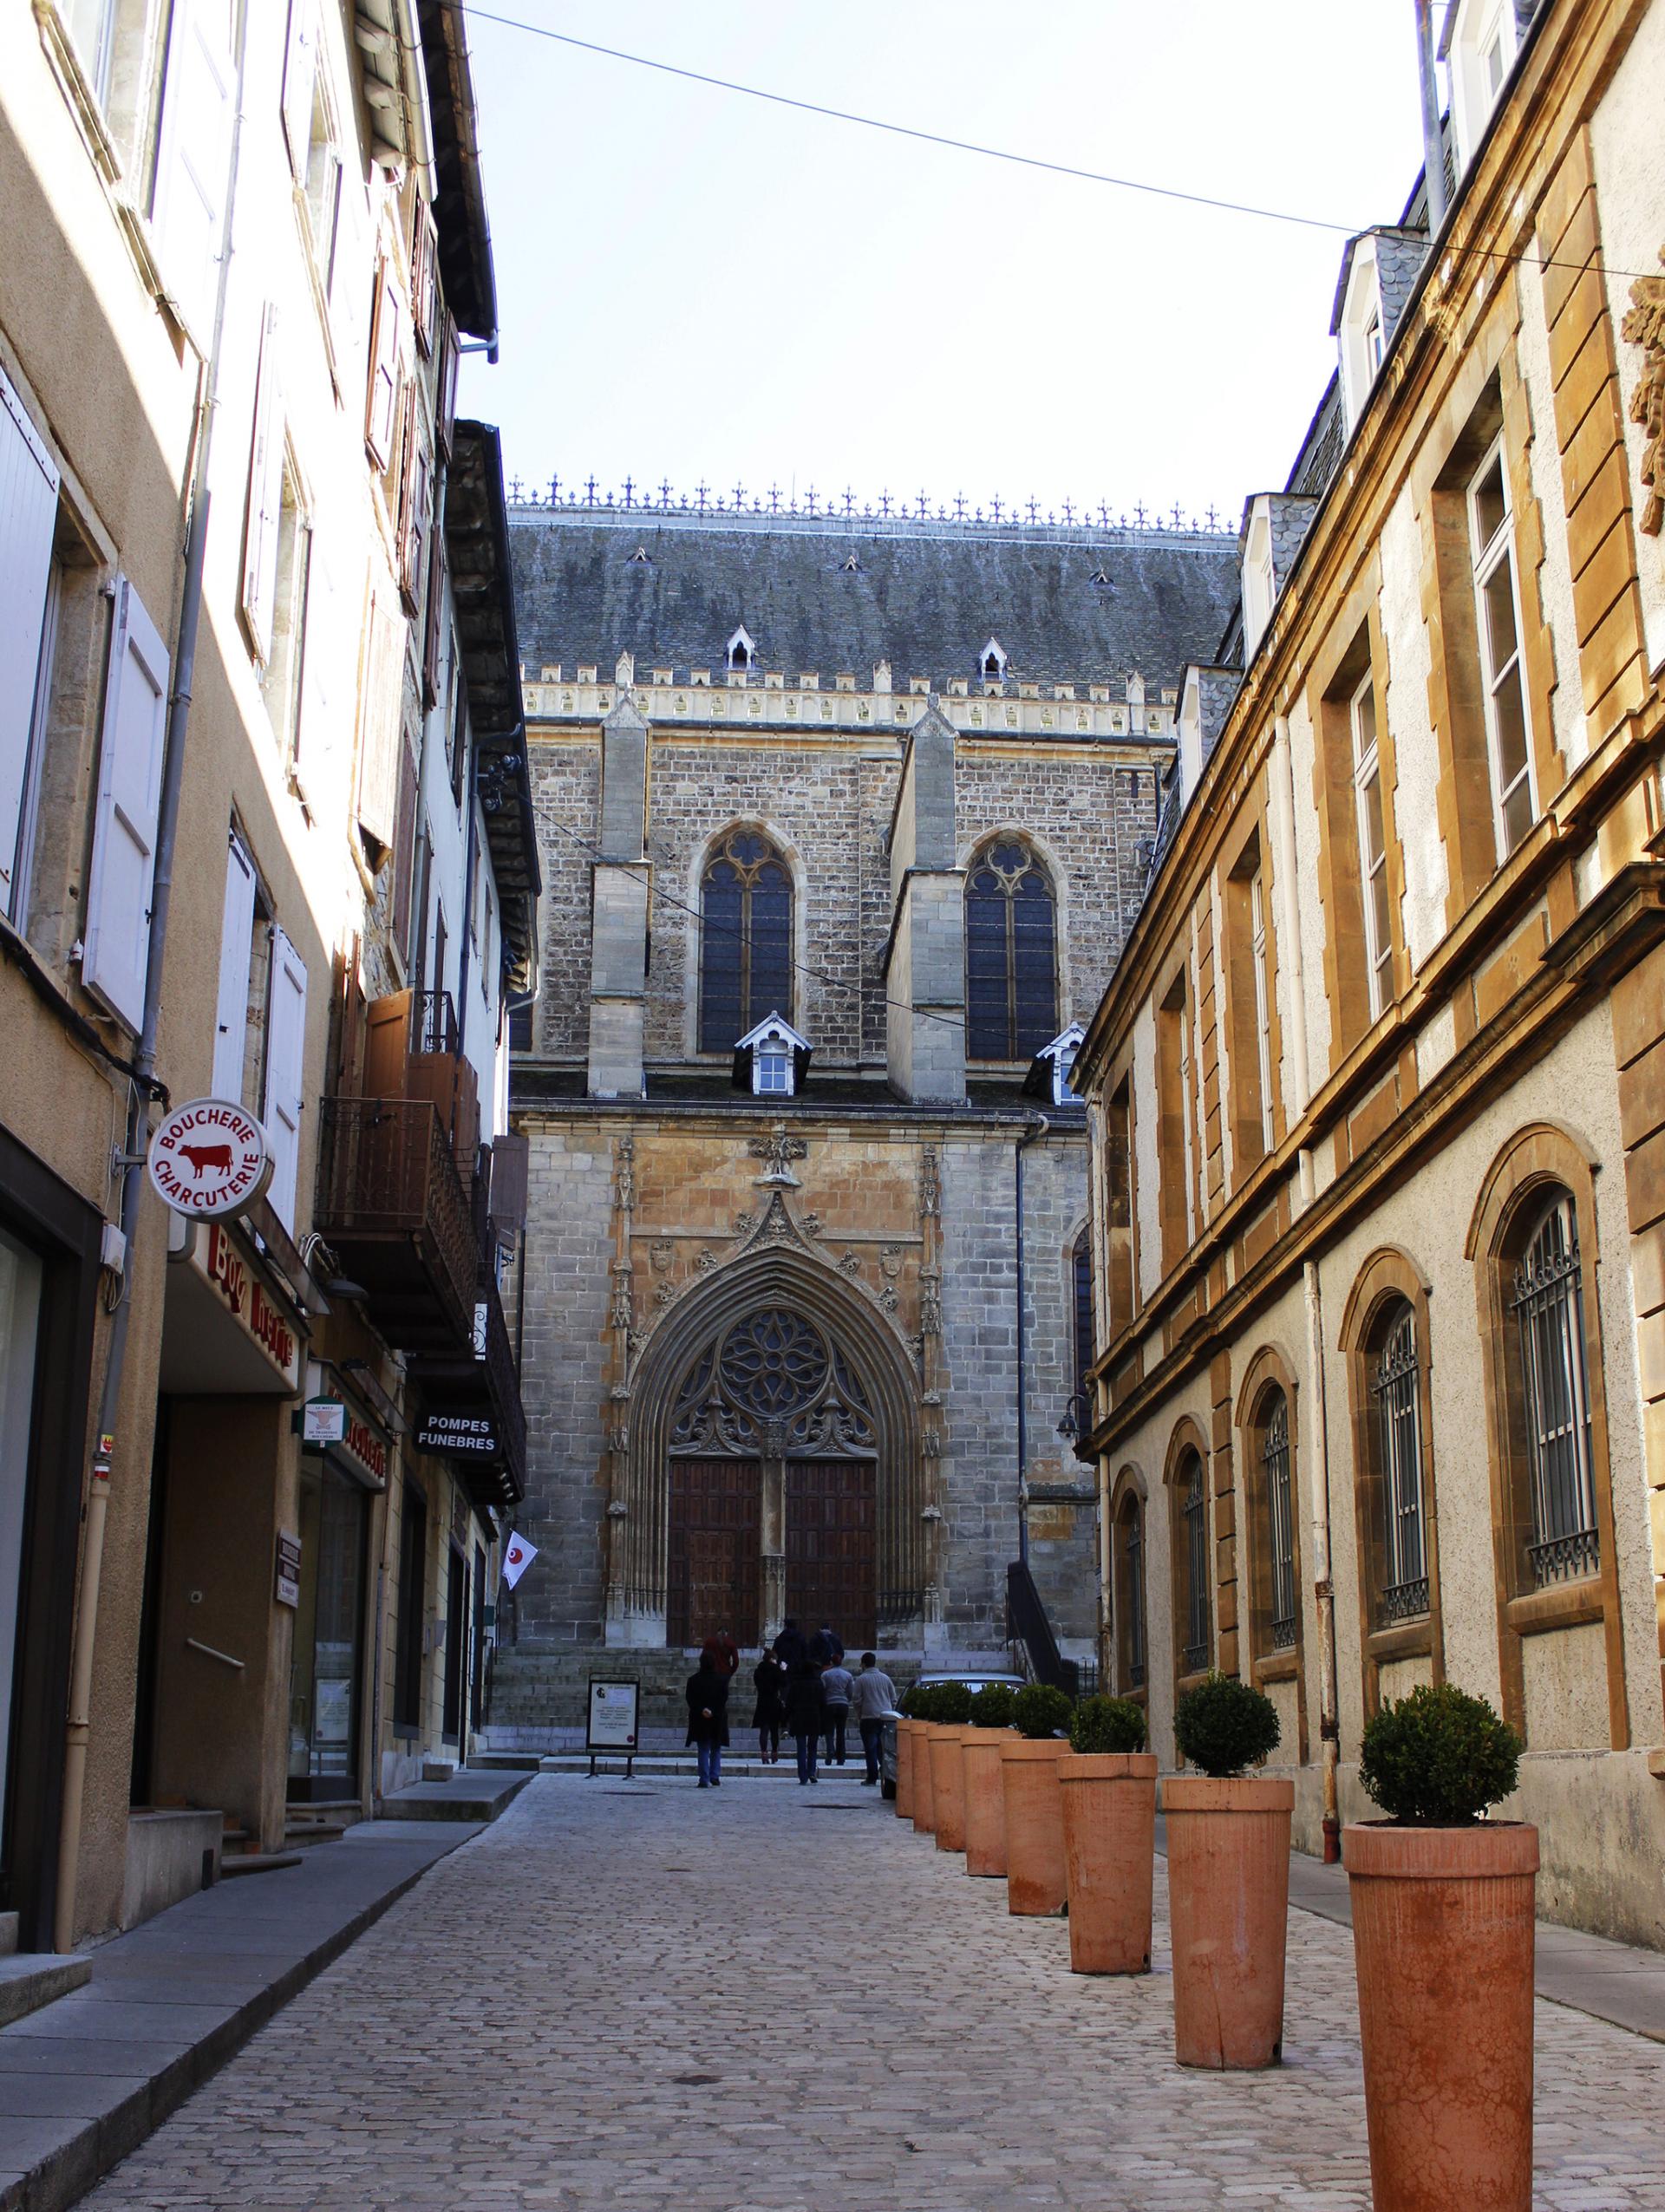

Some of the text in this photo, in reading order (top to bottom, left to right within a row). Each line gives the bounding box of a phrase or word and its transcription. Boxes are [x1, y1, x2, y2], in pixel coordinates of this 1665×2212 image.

[159, 1108, 256, 1151] BOUCHERIE
[154, 1153, 259, 1207] CHARCUTERIE
[207, 1222, 293, 1367] Bouherie
[417, 1432, 495, 1451] FUNEBRES
[428, 1415, 490, 1433] POMPES
